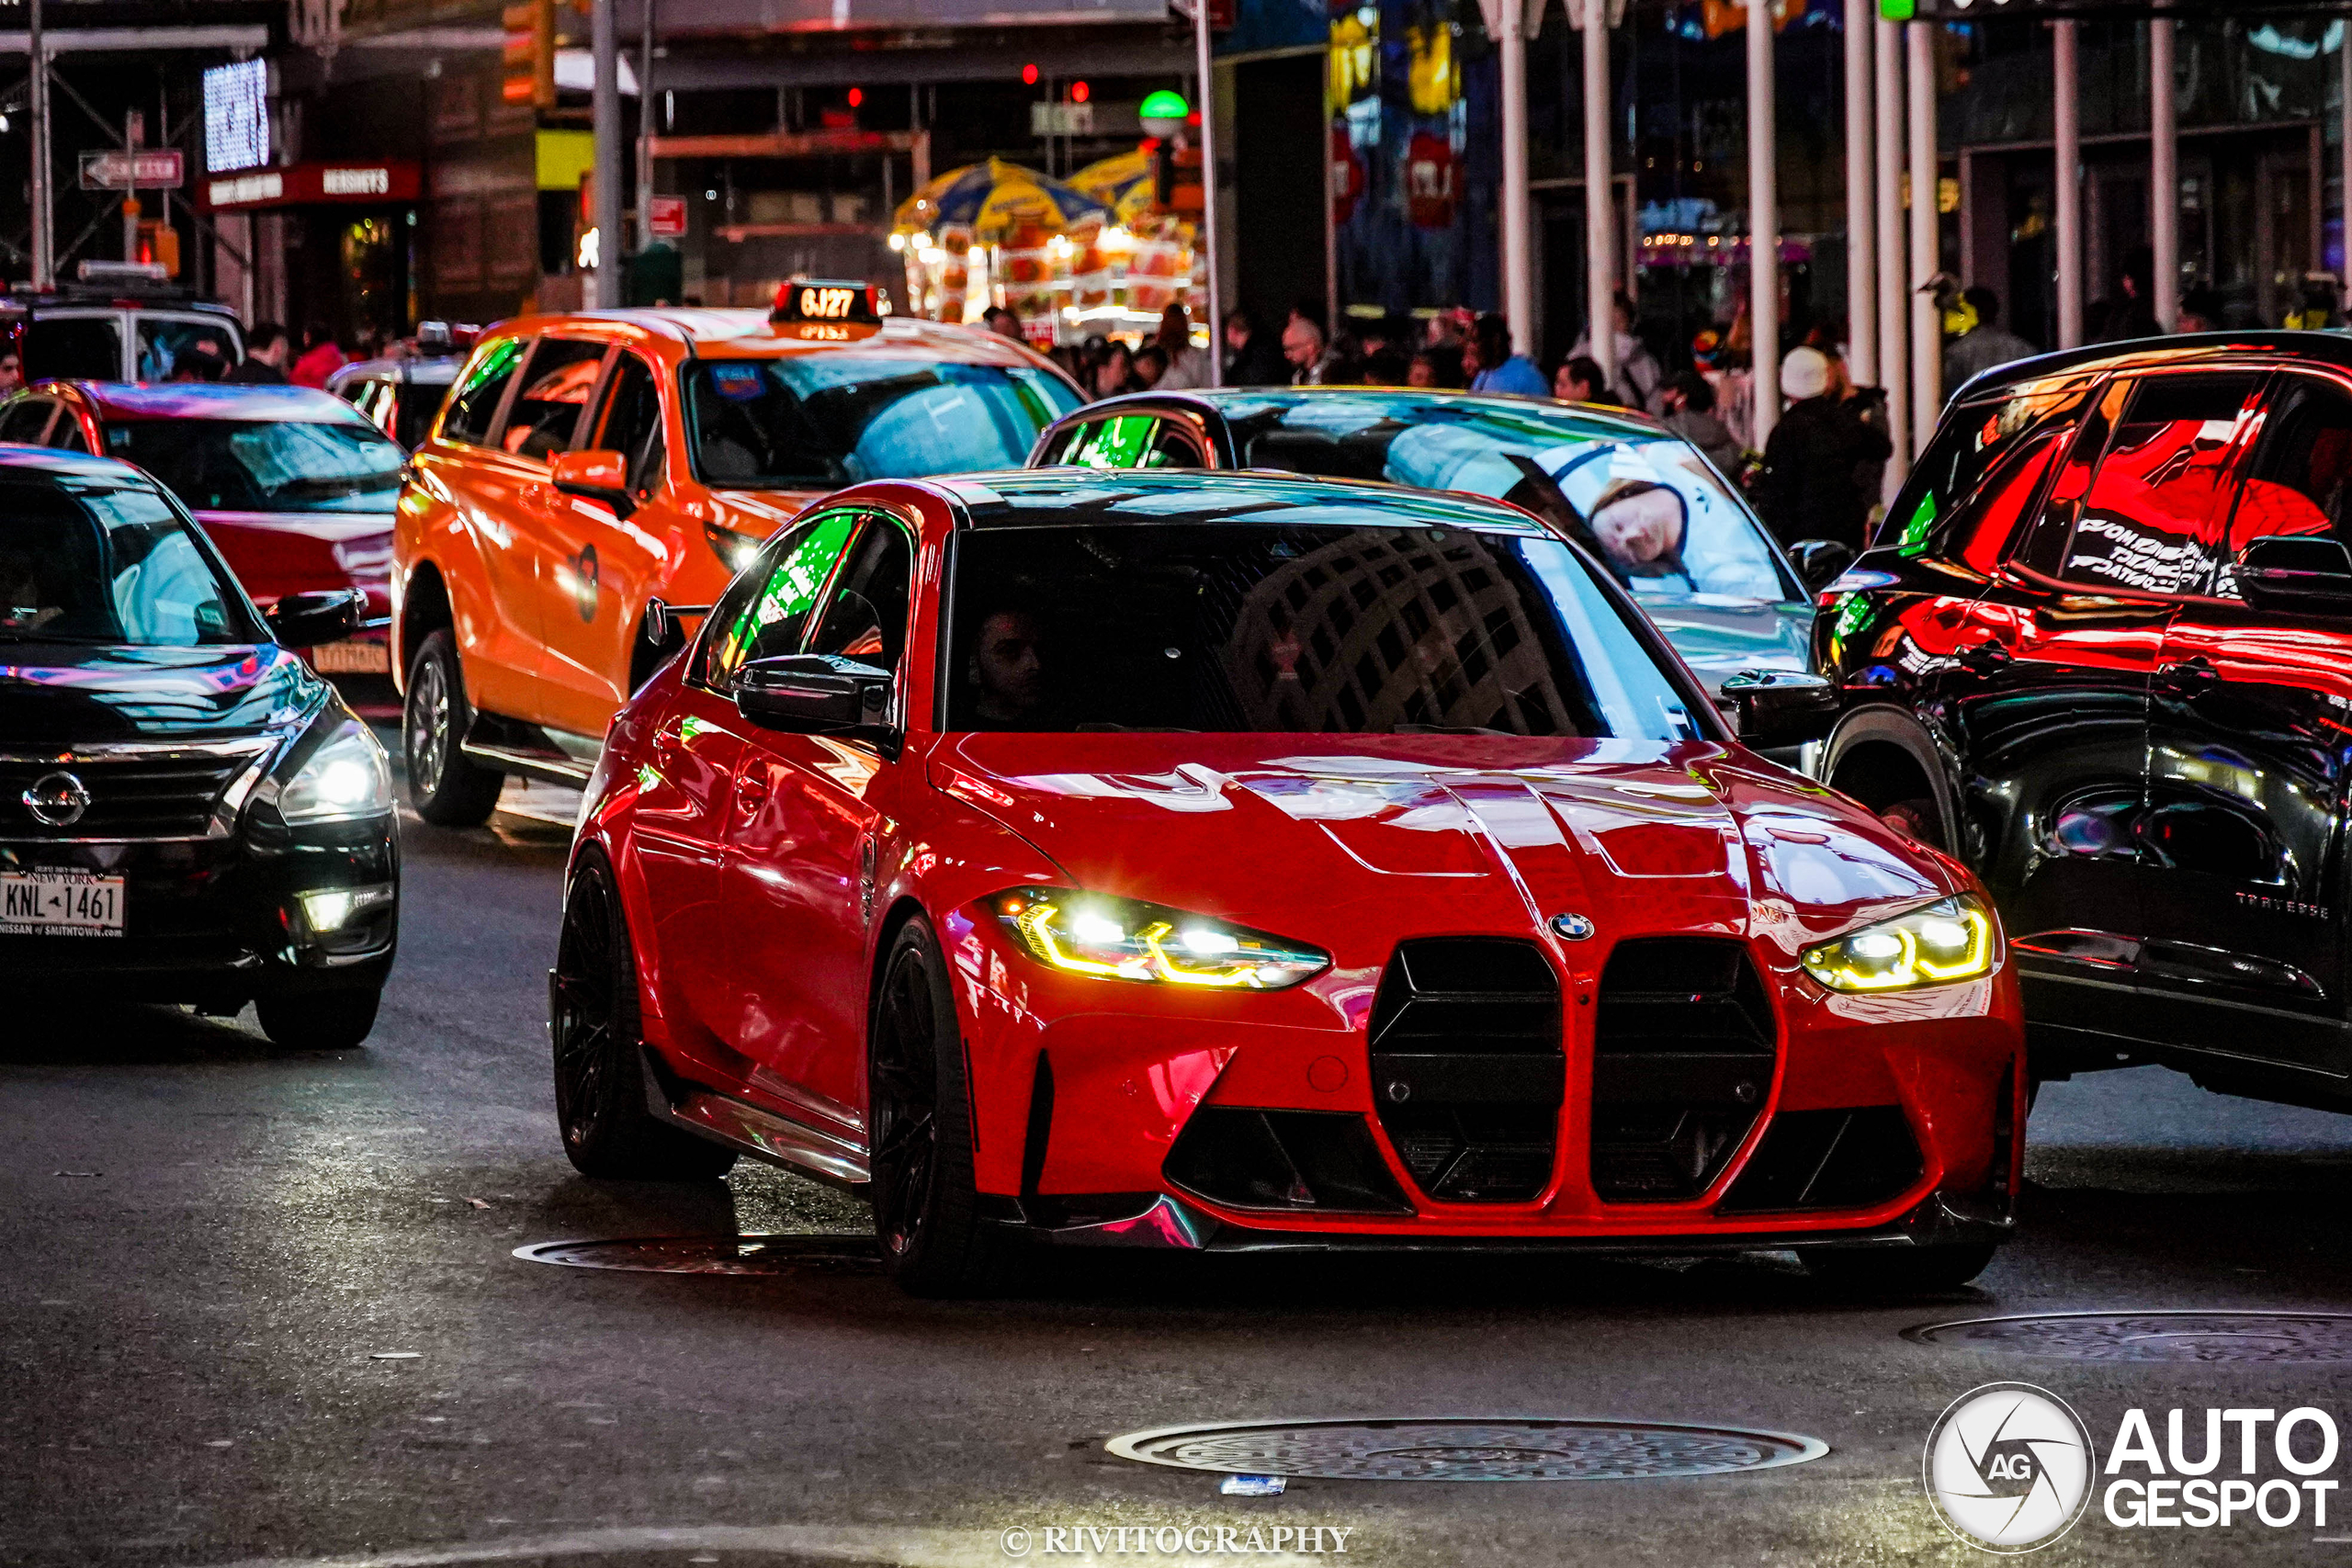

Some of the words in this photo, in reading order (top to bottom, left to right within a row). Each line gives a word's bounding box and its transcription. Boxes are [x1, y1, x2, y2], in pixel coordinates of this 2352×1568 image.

[800, 288, 855, 318] 6J27
[28, 873, 59, 884] NEW
[61, 874, 95, 885] YORK
[6, 884, 45, 917] KNL
[65, 886, 113, 919] 1461
[0, 922, 32, 934] NISSAN
